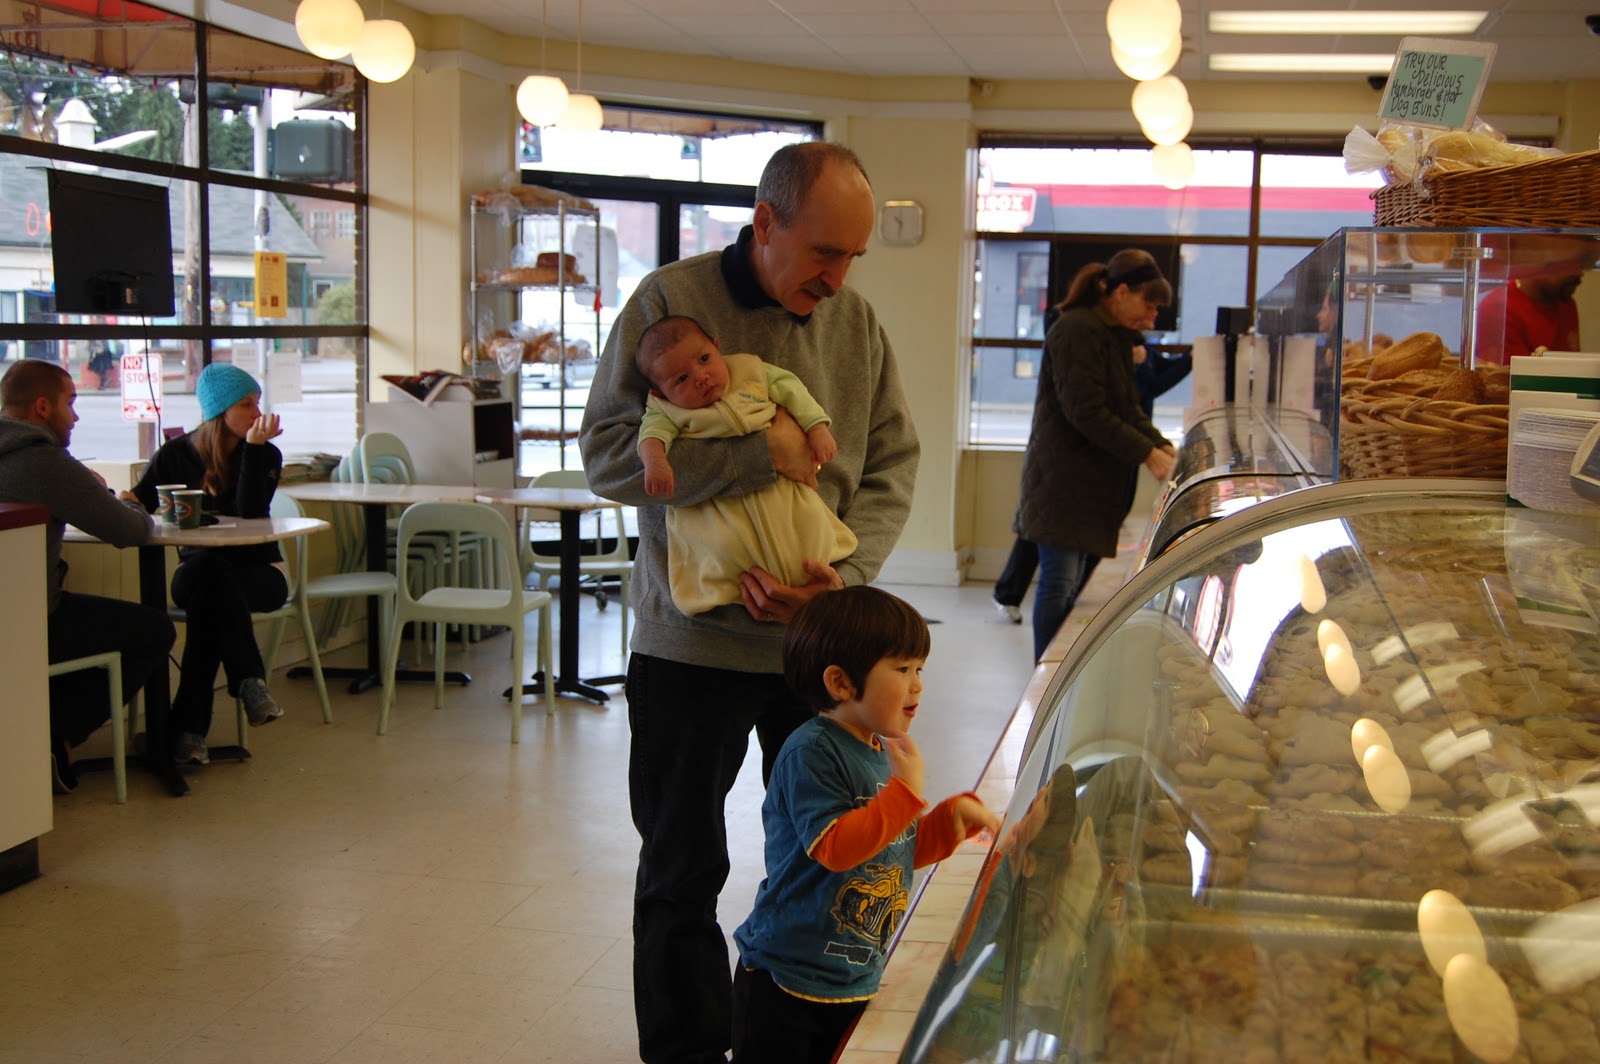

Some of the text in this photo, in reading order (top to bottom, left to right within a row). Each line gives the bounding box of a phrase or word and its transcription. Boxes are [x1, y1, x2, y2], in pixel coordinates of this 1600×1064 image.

[1405, 52, 1448, 70] TRY OUR
[1391, 79, 1435, 99] Hamburger
[1412, 69, 1465, 89] Delicious
[1390, 97, 1409, 118] Dog
[124, 357, 142, 369] NO
